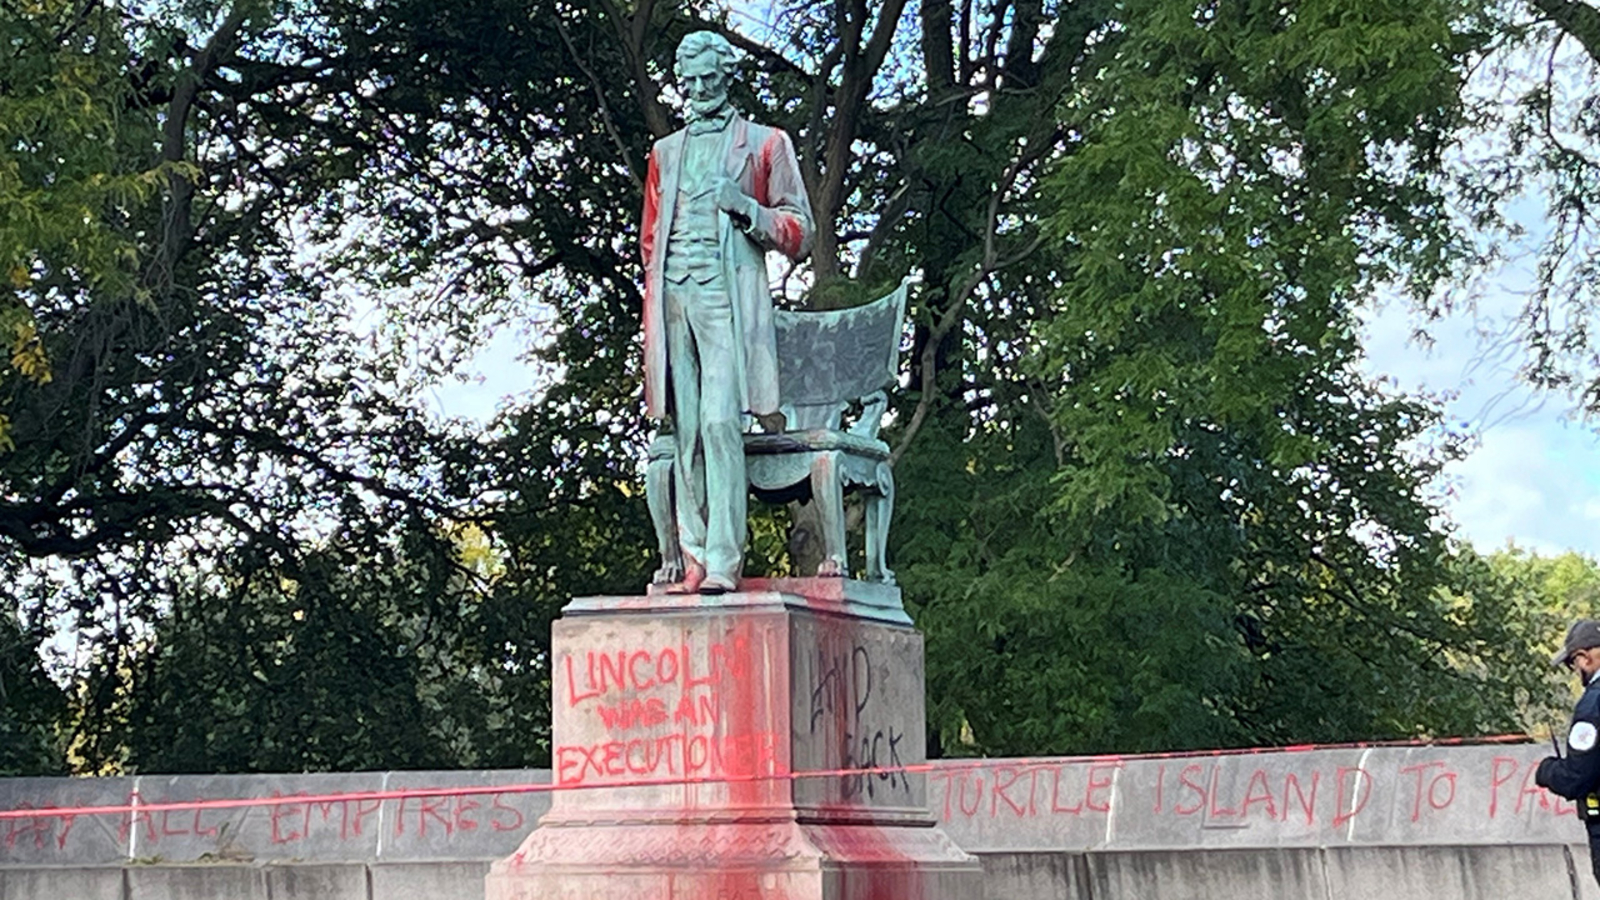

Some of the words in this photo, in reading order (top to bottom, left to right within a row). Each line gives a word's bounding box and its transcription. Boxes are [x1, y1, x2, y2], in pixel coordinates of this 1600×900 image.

[597, 697, 669, 730] WAS
[674, 692, 720, 727] AN
[271, 786, 523, 844] EMPIRES
[930, 762, 1124, 821] TURTLE
[1153, 764, 1372, 829] ISLAND
[1401, 760, 1458, 823] TO
